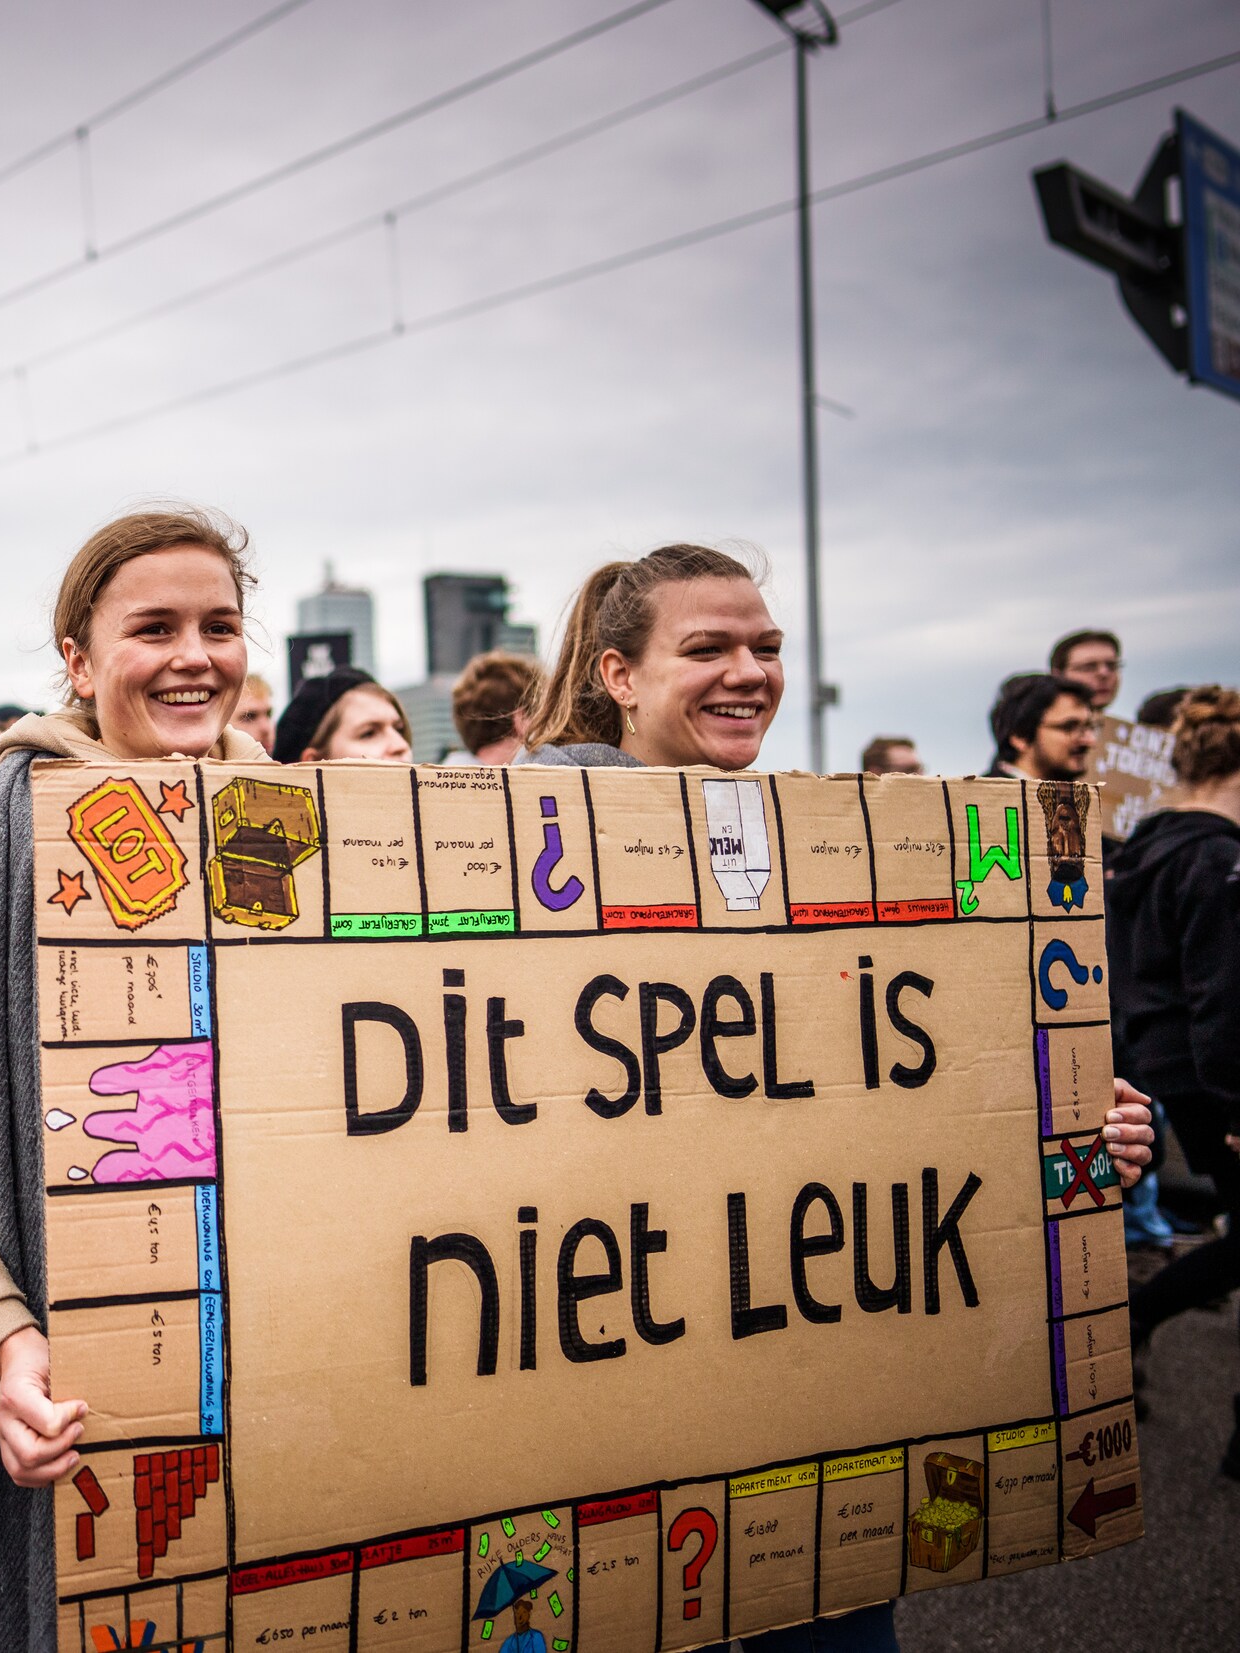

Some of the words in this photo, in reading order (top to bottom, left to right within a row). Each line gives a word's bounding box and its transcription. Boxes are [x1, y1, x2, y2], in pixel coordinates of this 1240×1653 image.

[722, 825, 733, 834] EN
[90, 806, 166, 884] LOT
[343, 838, 382, 848] maand
[387, 837, 404, 848] per
[435, 841, 475, 850] maand
[479, 837, 494, 849] per
[624, 839, 654, 855] miljoen
[710, 838, 743, 856] MELK
[811, 841, 840, 854] miljoen
[122, 956, 134, 974] per
[191, 952, 202, 992] STUDIO
[127, 982, 136, 1025] maand
[341, 967, 538, 1137] Dit
[150, 1242, 160, 1264] ton
[409, 1202, 686, 1387] niet
[152, 1343, 163, 1366] ton
[995, 1429, 1026, 1445] STUDIO
[825, 1455, 887, 1476] APPARTEMENT
[730, 1475, 792, 1495] APPARTEMENT
[840, 1530, 858, 1546] per
[862, 1521, 894, 1539] maand
[476, 1550, 503, 1579] RIJKE
[506, 1532, 541, 1553] OUDERS
[625, 1556, 639, 1567] ton
[749, 1553, 766, 1568] per
[770, 1546, 804, 1560] maand
[408, 1608, 428, 1621] ton
[255, 1628, 294, 1645] €650
[301, 1626, 317, 1640] per
